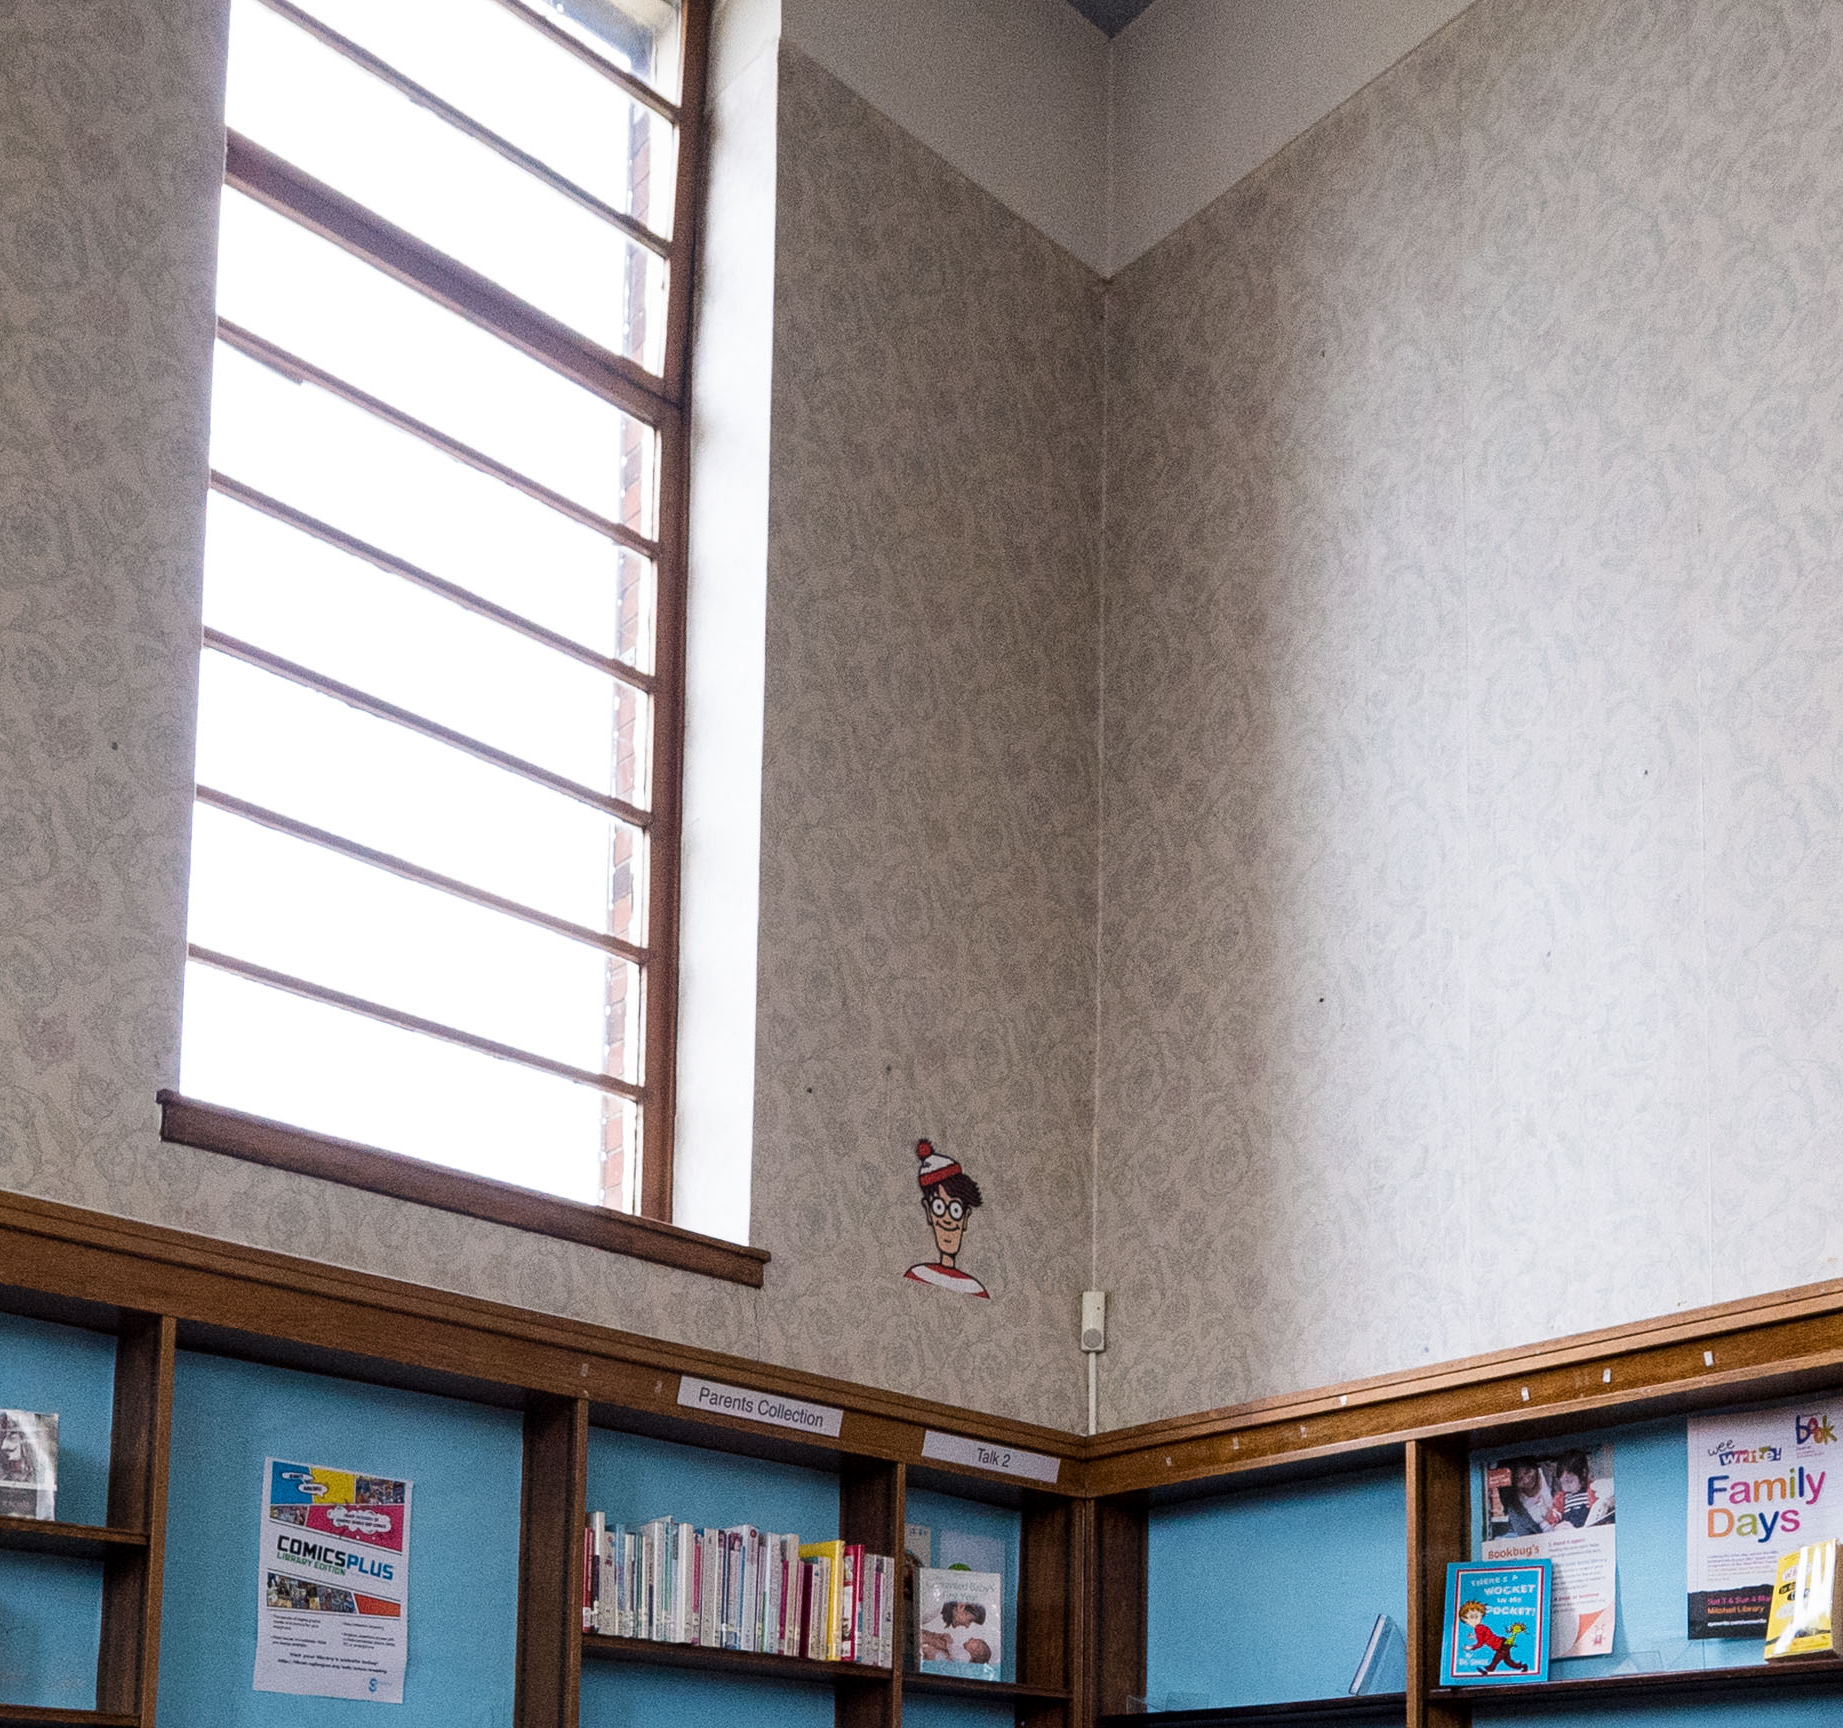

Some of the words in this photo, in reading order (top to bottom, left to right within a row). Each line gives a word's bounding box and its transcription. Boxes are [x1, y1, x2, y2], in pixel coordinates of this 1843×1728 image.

[699, 1387, 753, 1414] Parents
[757, 1399, 824, 1428] Collection
[977, 1447, 999, 1466] Talk
[1001, 1454, 1011, 1468] 2
[1708, 1440, 1735, 1457] wee
[1720, 1447, 1782, 1466] write!
[1707, 1466, 1826, 1506] Family
[1707, 1508, 1801, 1544] Days
[1488, 1544, 1540, 1560] Bookbug's
[277, 1551, 312, 1569] LIBRARY
[314, 1560, 346, 1576] EDITION
[1484, 1585, 1536, 1595] WOCKET
[1486, 1607, 1536, 1616] POCKET!
